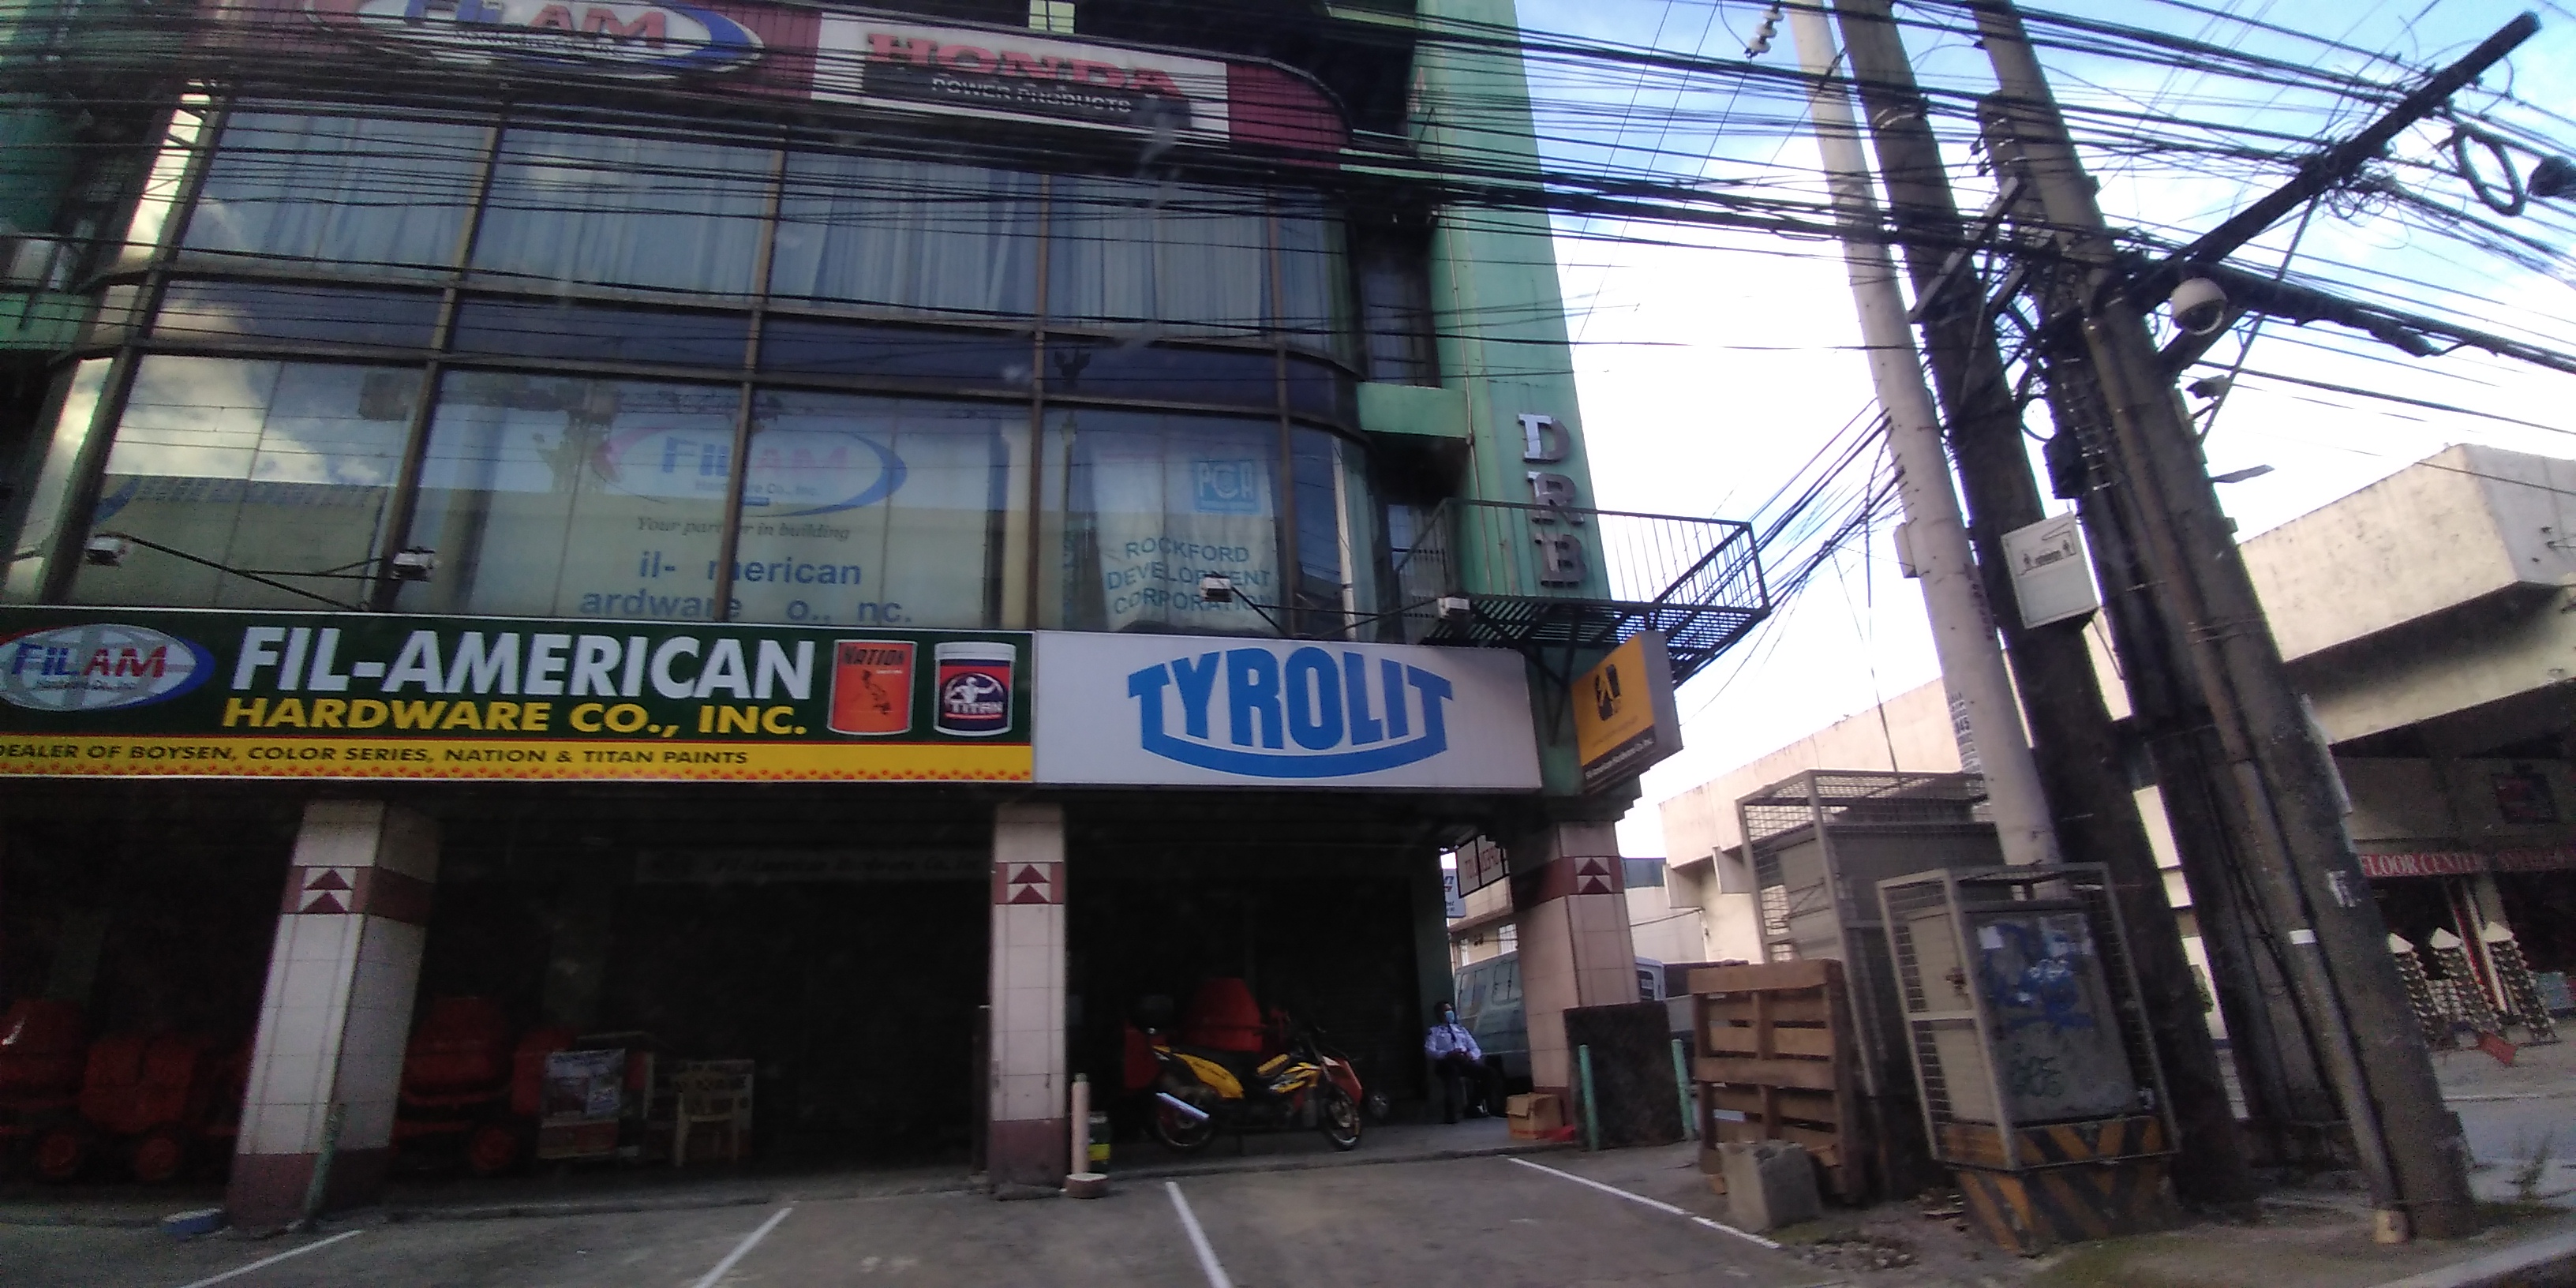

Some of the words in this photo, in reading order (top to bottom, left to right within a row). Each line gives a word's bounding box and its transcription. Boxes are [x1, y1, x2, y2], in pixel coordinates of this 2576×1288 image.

[867, 33, 1183, 99] HONDA
[932, 77, 1011, 100] POWER
[1017, 86, 1131, 113] PRODUCTS
[638, 517, 680, 534] Your
[778, 522, 851, 541] building
[1125, 537, 1249, 563] ROCKFORD
[1107, 561, 1271, 590] DEVELOPENT
[11, 642, 167, 679] FILAM
[230, 626, 816, 701] FIL-AMERICAN
[222, 696, 551, 732] HARDWARE
[569, 702, 680, 739] CO.,
[698, 705, 808, 736] INC.
[949, 700, 1004, 714] TITAN
[1128, 646, 1454, 778] TYROLIT
[87, 745, 122, 758] OF
[129, 745, 237, 761] BOYSEN,
[248, 746, 337, 761] COLOR
[345, 747, 433, 762] SERIES,
[444, 748, 548, 762] NATION
[556, 750, 573, 763] &
[583, 750, 654, 764] TITAN
[663, 751, 749, 765] PAINTS
